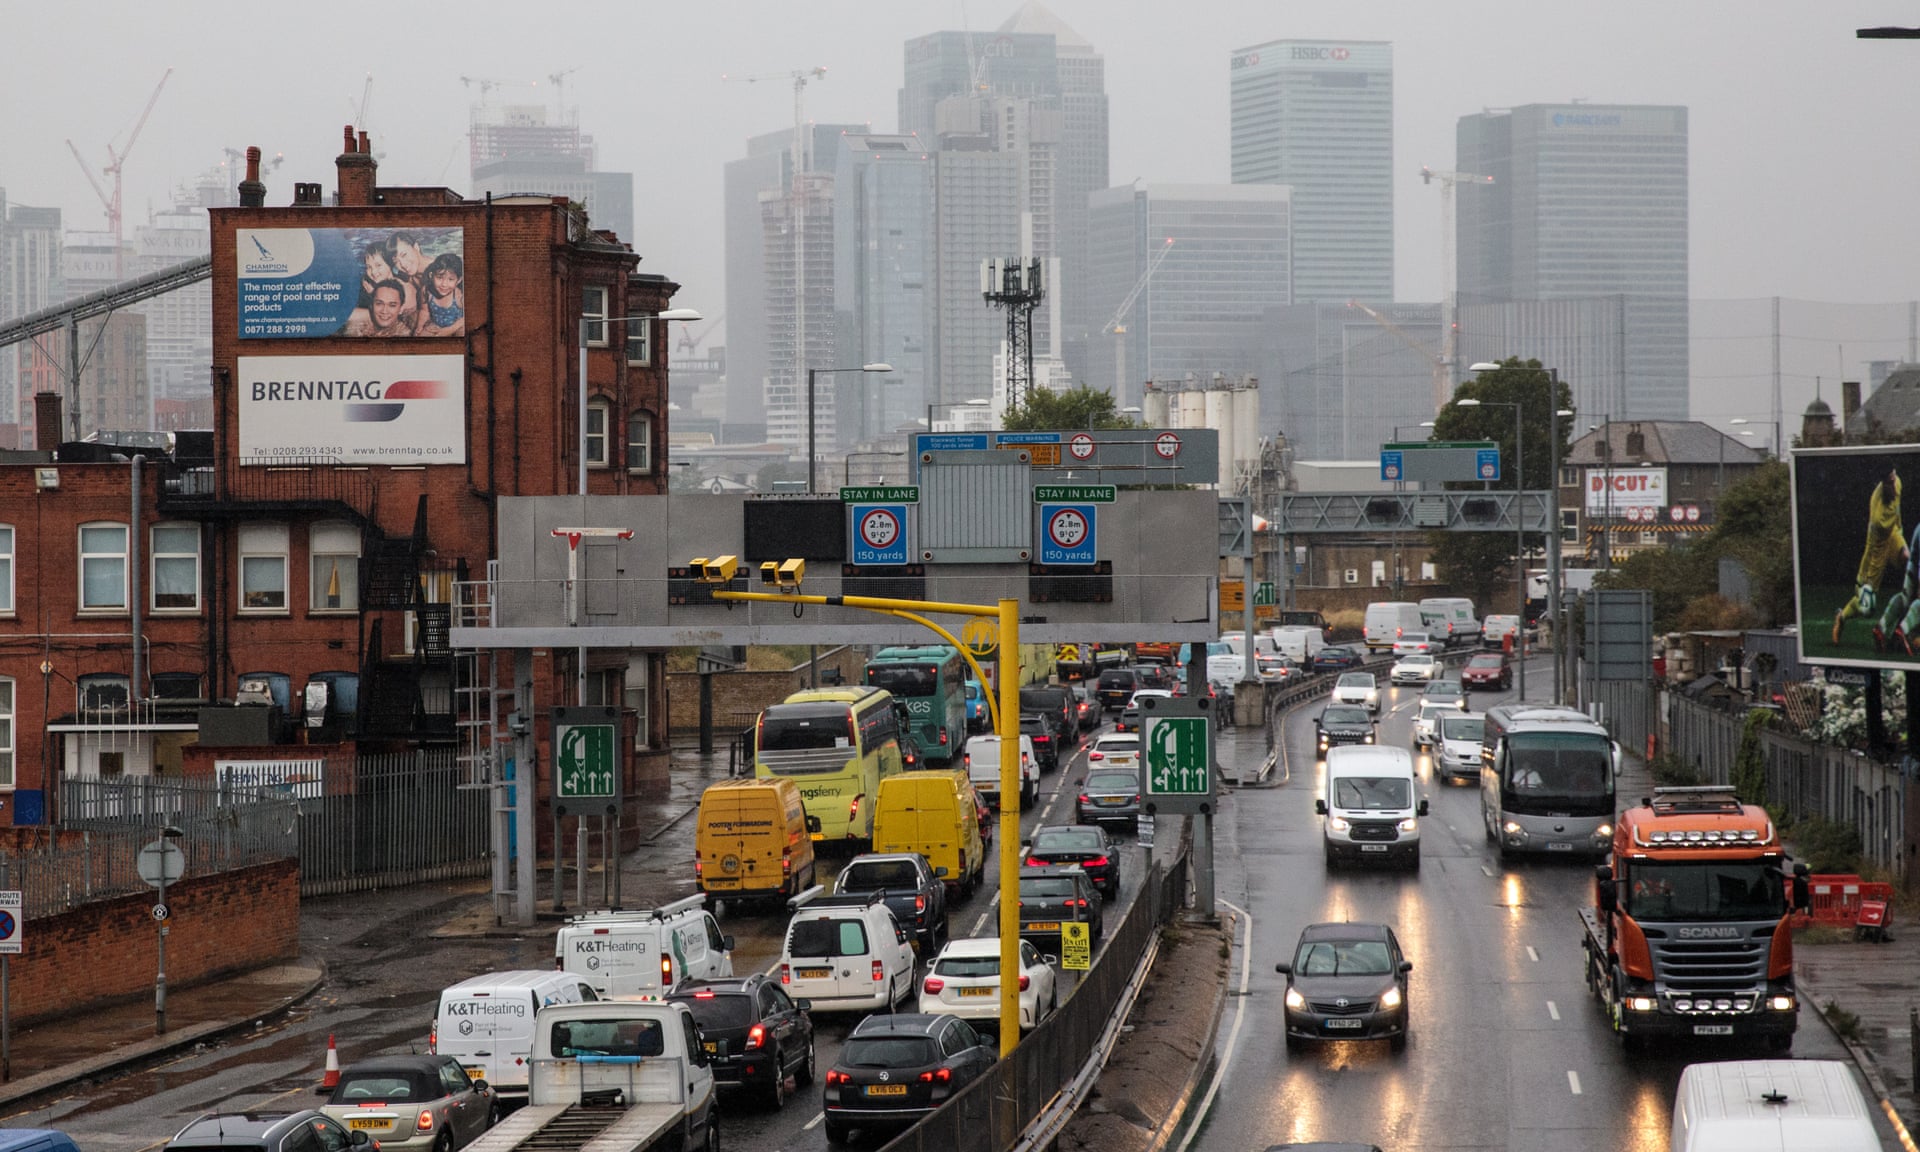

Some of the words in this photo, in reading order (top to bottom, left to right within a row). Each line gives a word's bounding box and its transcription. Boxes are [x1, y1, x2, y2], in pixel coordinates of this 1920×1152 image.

[1291, 47, 1329, 60] HSBC
[244, 283, 260, 291] The
[262, 282, 284, 291] most
[286, 282, 303, 290] cost
[305, 282, 341, 290] effective
[244, 294, 270, 303] range
[272, 293, 281, 301] of
[283, 292, 302, 302] pool
[304, 292, 322, 300] and
[324, 293, 340, 302] spa
[244, 303, 282, 313] products
[245, 326, 264, 334] 0871
[266, 326, 282, 334] 288
[285, 325, 306, 333] 2998
[252, 381, 381, 401] BRENNTAG
[254, 447, 270, 456] Tel:
[272, 448, 297, 456] 0208
[299, 447, 317, 455] 293
[318, 446, 344, 454] 4343
[352, 446, 453, 457] www.brenntag.co.uk
[843, 490, 869, 499] STAY
[872, 490, 884, 499] IN
[888, 490, 916, 498] LANE
[1039, 490, 1064, 498] STAY
[1068, 490, 1080, 498] IN
[1084, 489, 1112, 498] LANE
[870, 520, 892, 529] 2.8m
[1058, 520, 1081, 528] 2.8m
[858, 551, 874, 560] 150
[877, 551, 904, 561] yards
[1046, 550, 1062, 559] 150
[1065, 550, 1092, 560] yards
[905, 698, 931, 714] kes
[800, 785, 842, 799] ngsferry
[1679, 927, 1739, 938] SCANIA
